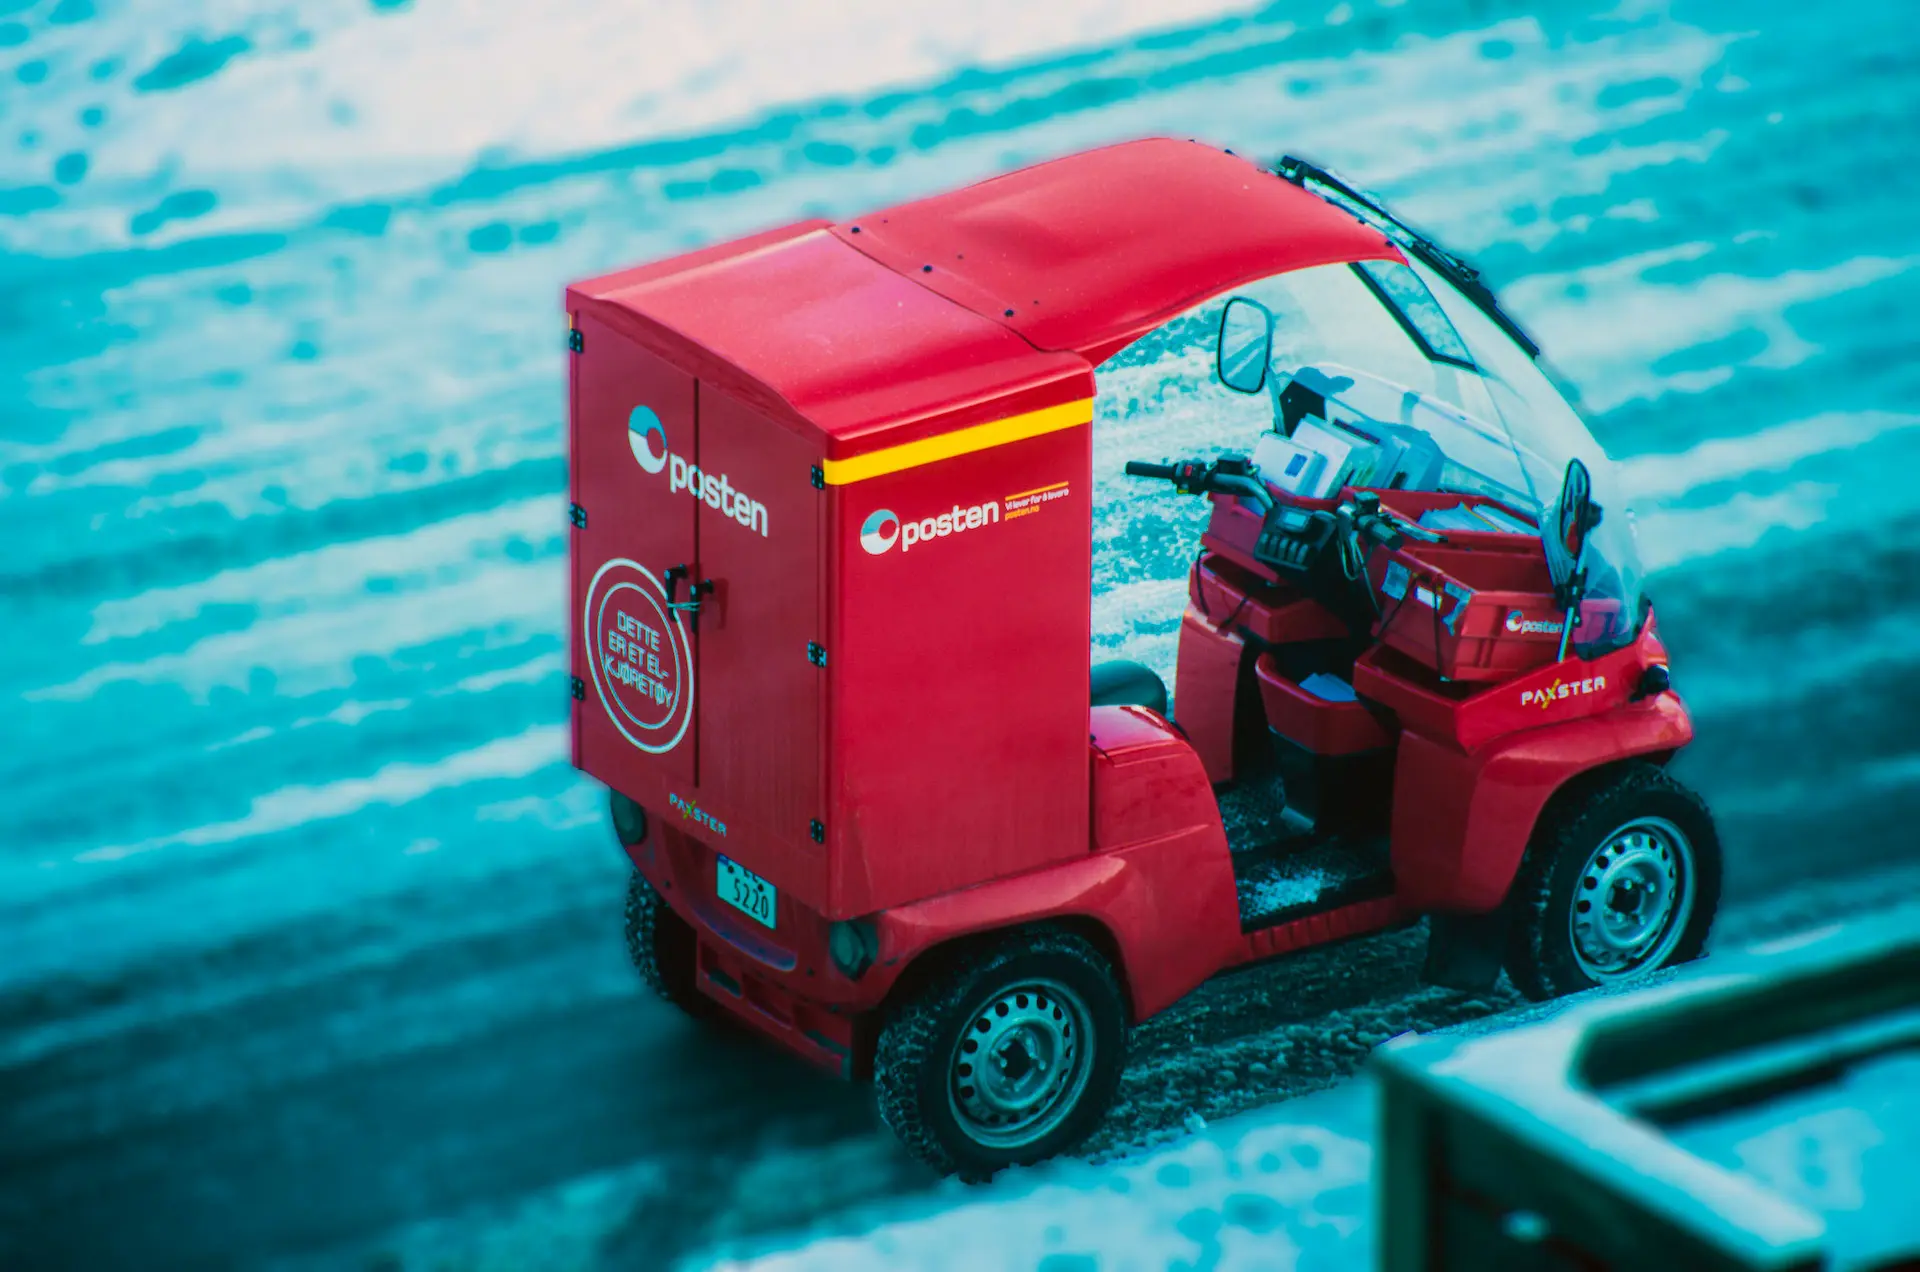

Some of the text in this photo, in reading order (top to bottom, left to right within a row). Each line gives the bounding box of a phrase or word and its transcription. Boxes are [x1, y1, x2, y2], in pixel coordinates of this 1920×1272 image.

[669, 452, 768, 537] posten
[1005, 505, 1040, 521] posten.no
[901, 501, 999, 552] posten
[617, 609, 660, 652] DETTE
[1520, 620, 1563, 634] posten
[608, 629, 669, 679] ER ET EL-
[604, 653, 673, 708] KJØRETØY
[1521, 675, 1606, 709] PAXSTER
[669, 792, 727, 837] PAXSTER
[733, 878, 769, 919] 5220
